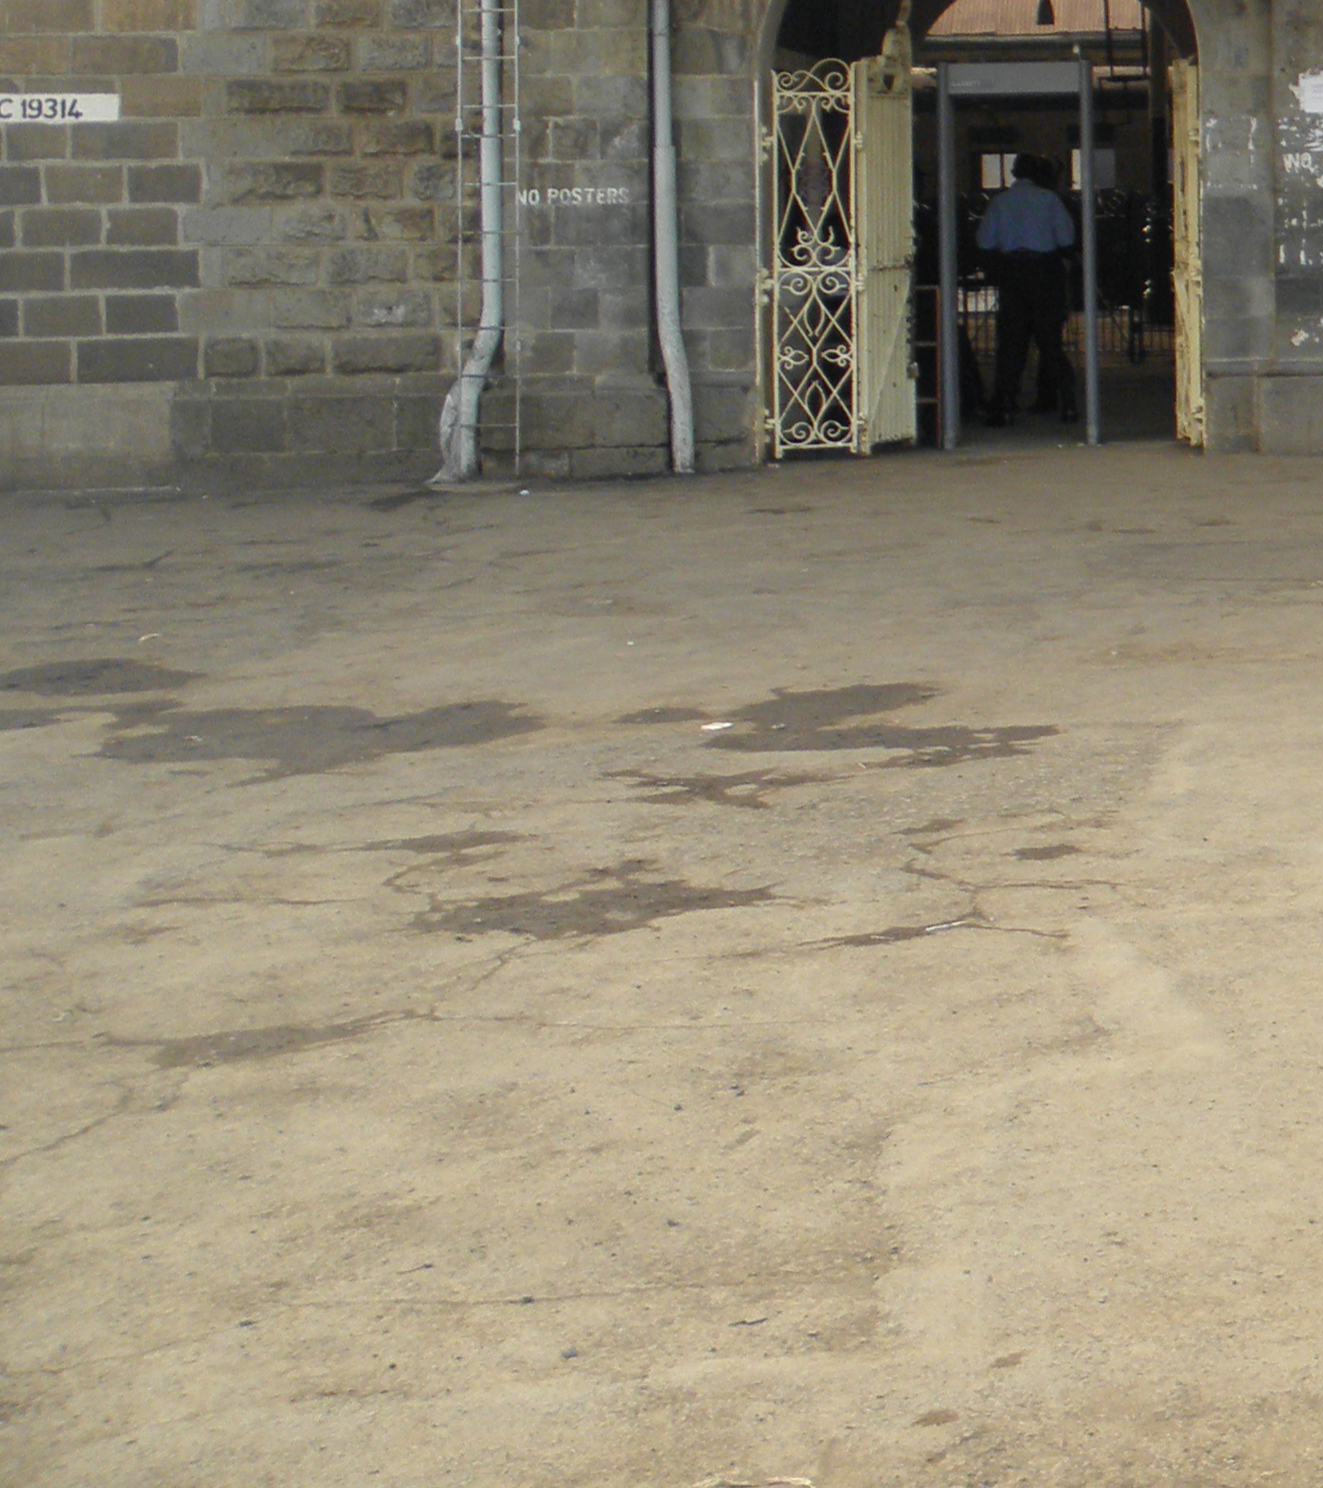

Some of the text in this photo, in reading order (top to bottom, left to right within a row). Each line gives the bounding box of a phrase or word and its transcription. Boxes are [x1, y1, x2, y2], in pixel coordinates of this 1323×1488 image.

[21, 98, 83, 119] 19314
[1283, 151, 1312, 172] NO
[516, 187, 629, 205] NO POSTERS
